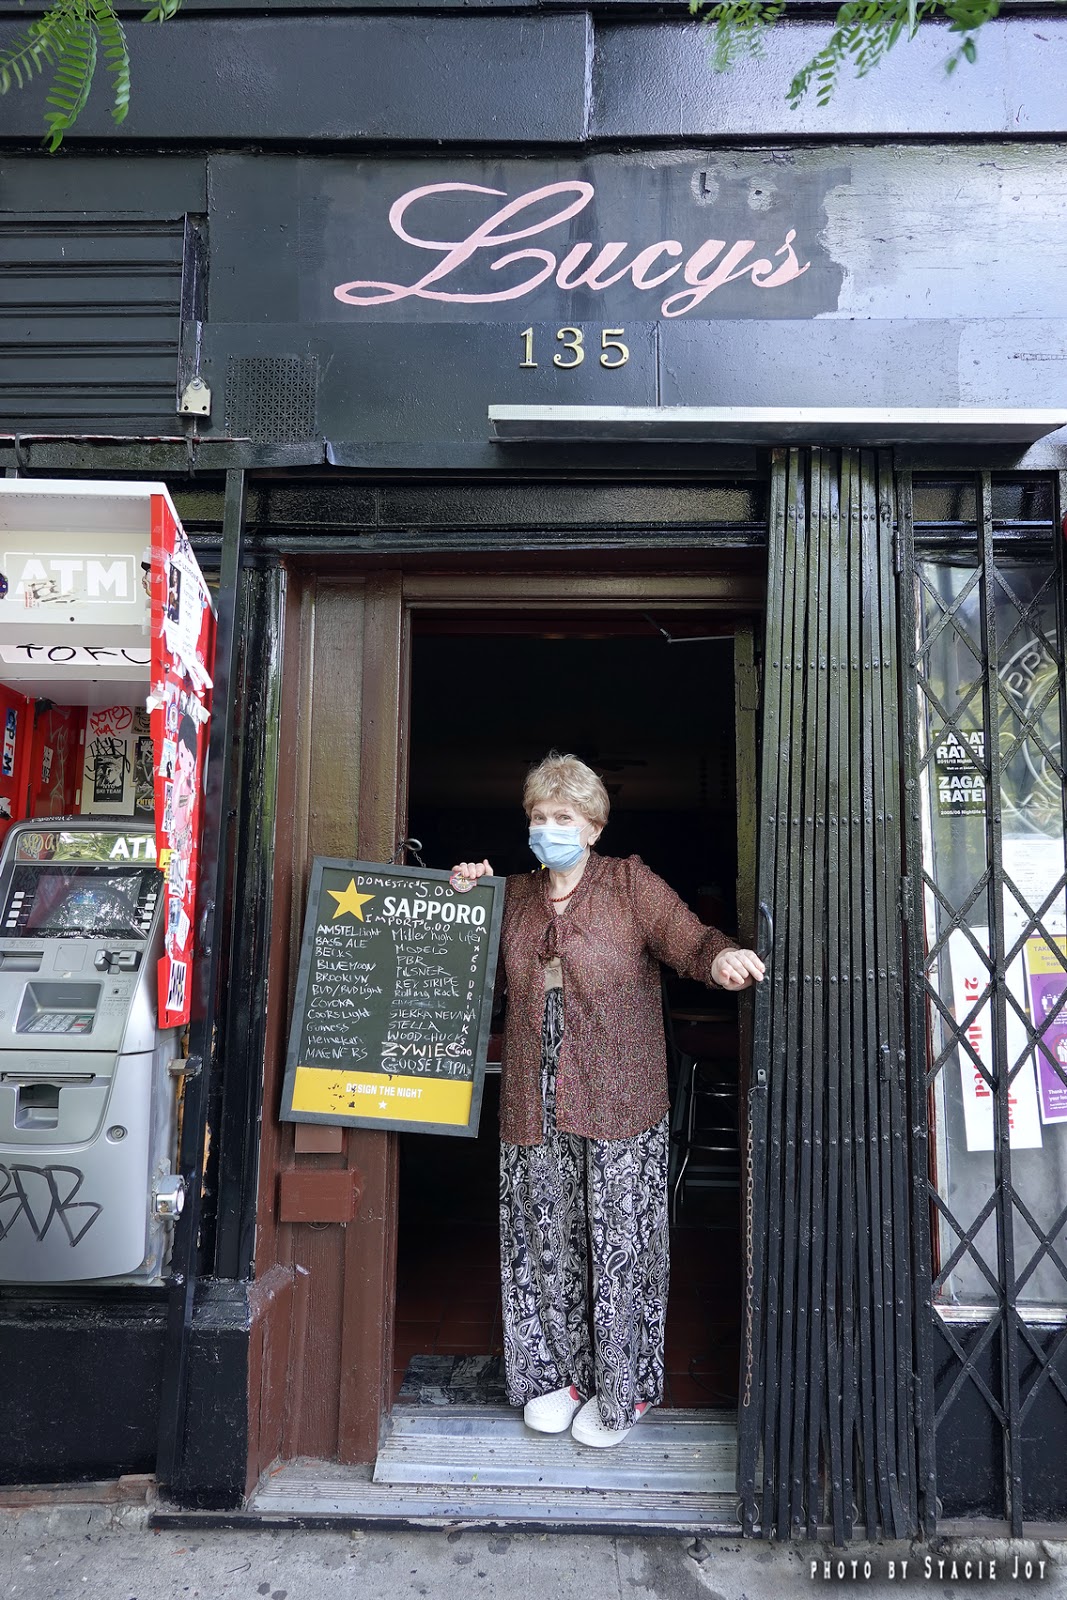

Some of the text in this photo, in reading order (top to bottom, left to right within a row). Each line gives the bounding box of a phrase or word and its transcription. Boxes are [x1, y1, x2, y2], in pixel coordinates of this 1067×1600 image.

[519, 326, 631, 369] 135
[15, 559, 128, 597] ATM
[938, 775, 985, 789] ZAGA
[382, 896, 486, 926] SAPPORO
[391, 927, 427, 941] Miller
[345, 938, 368, 949] ALE
[396, 955, 428, 967] PBR
[388, 1020, 441, 1033] STELLA
[345, 1083, 423, 1099] DESIGN THE NIGHT
